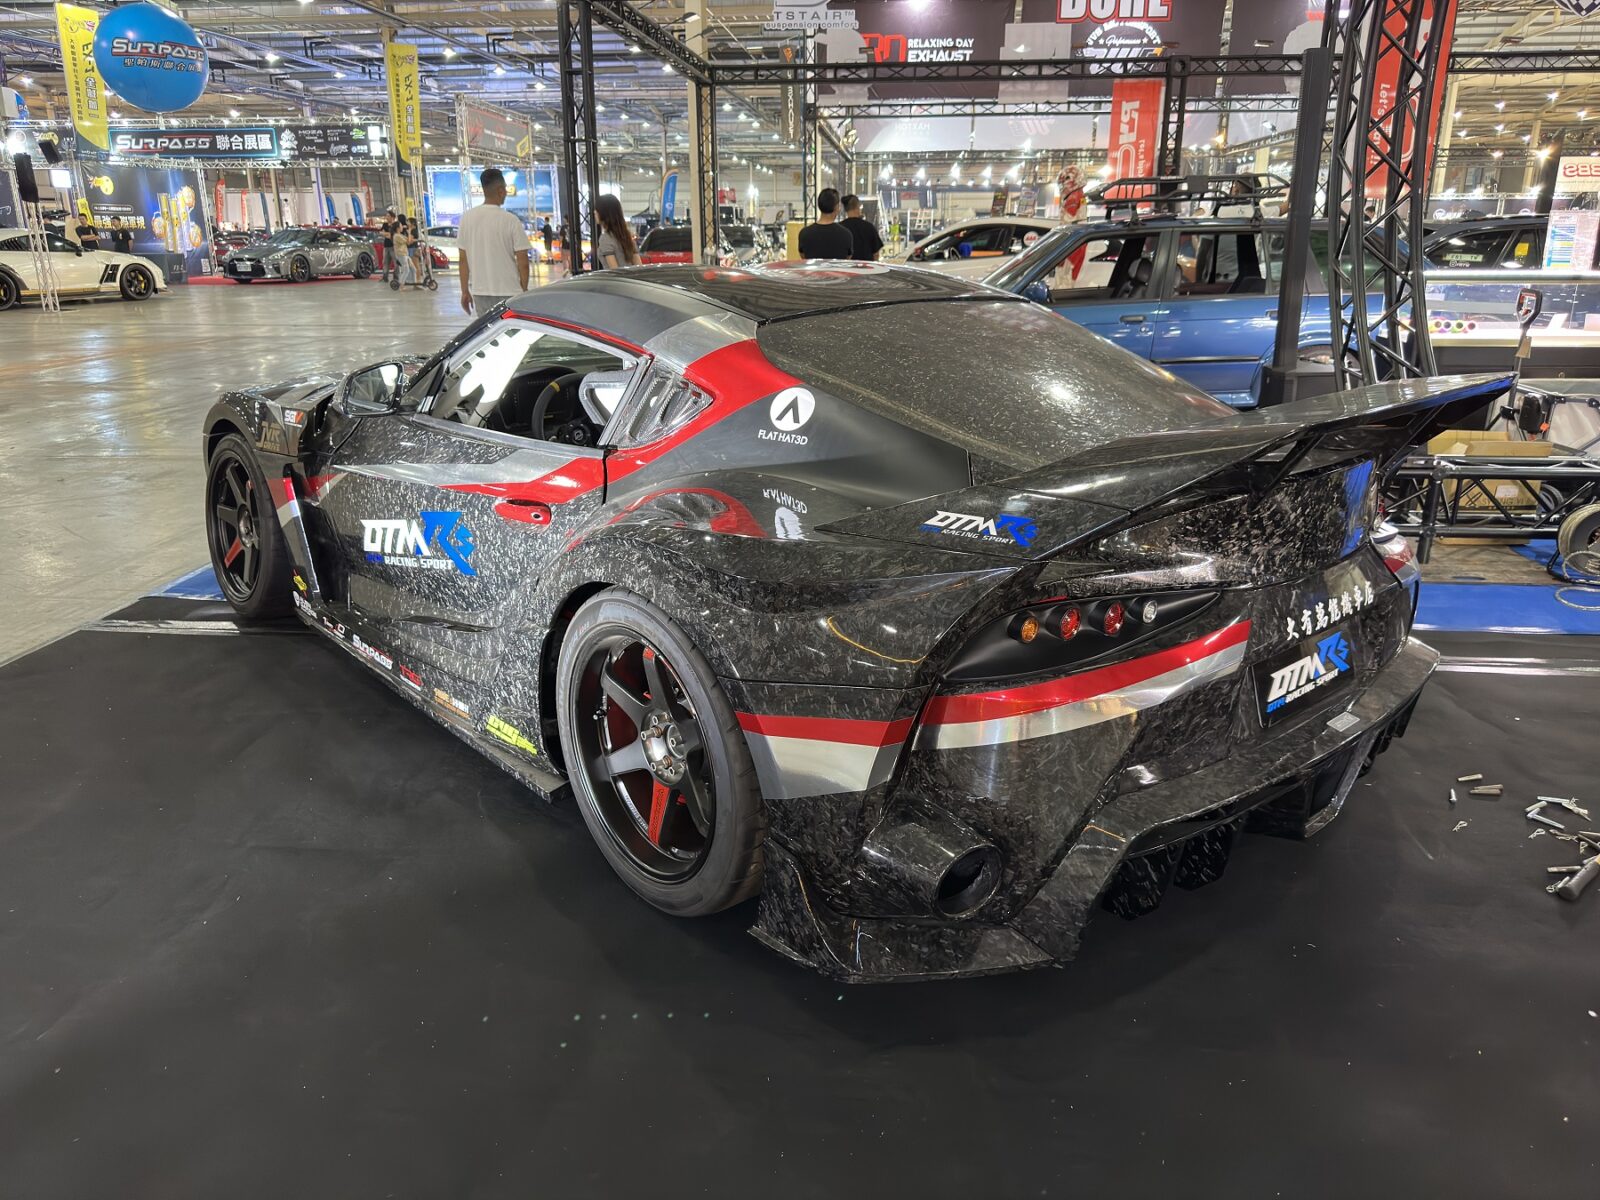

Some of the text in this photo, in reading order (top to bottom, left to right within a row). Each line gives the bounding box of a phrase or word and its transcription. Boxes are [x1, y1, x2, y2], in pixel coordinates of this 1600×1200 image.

[822, 21, 859, 29] comfort
[908, 38, 974, 48] RELAXING DAY
[907, 50, 974, 62] EXHAUST
[1377, 83, 1390, 116] Let's
[117, 134, 273, 151] SURPASS 聯合展區
[757, 429, 778, 441] FLAT
[923, 510, 998, 536] DTM
[360, 519, 431, 556] DTM
[941, 529, 980, 539] RACING
[981, 535, 1016, 544] SPORT
[384, 556, 418, 568] RACING
[421, 559, 454, 570] SPORT
[352, 633, 394, 670] SURPASS
[1267, 652, 1327, 702] DTM
[1285, 681, 1316, 703] RACING
[1316, 668, 1340, 686] SPORT
